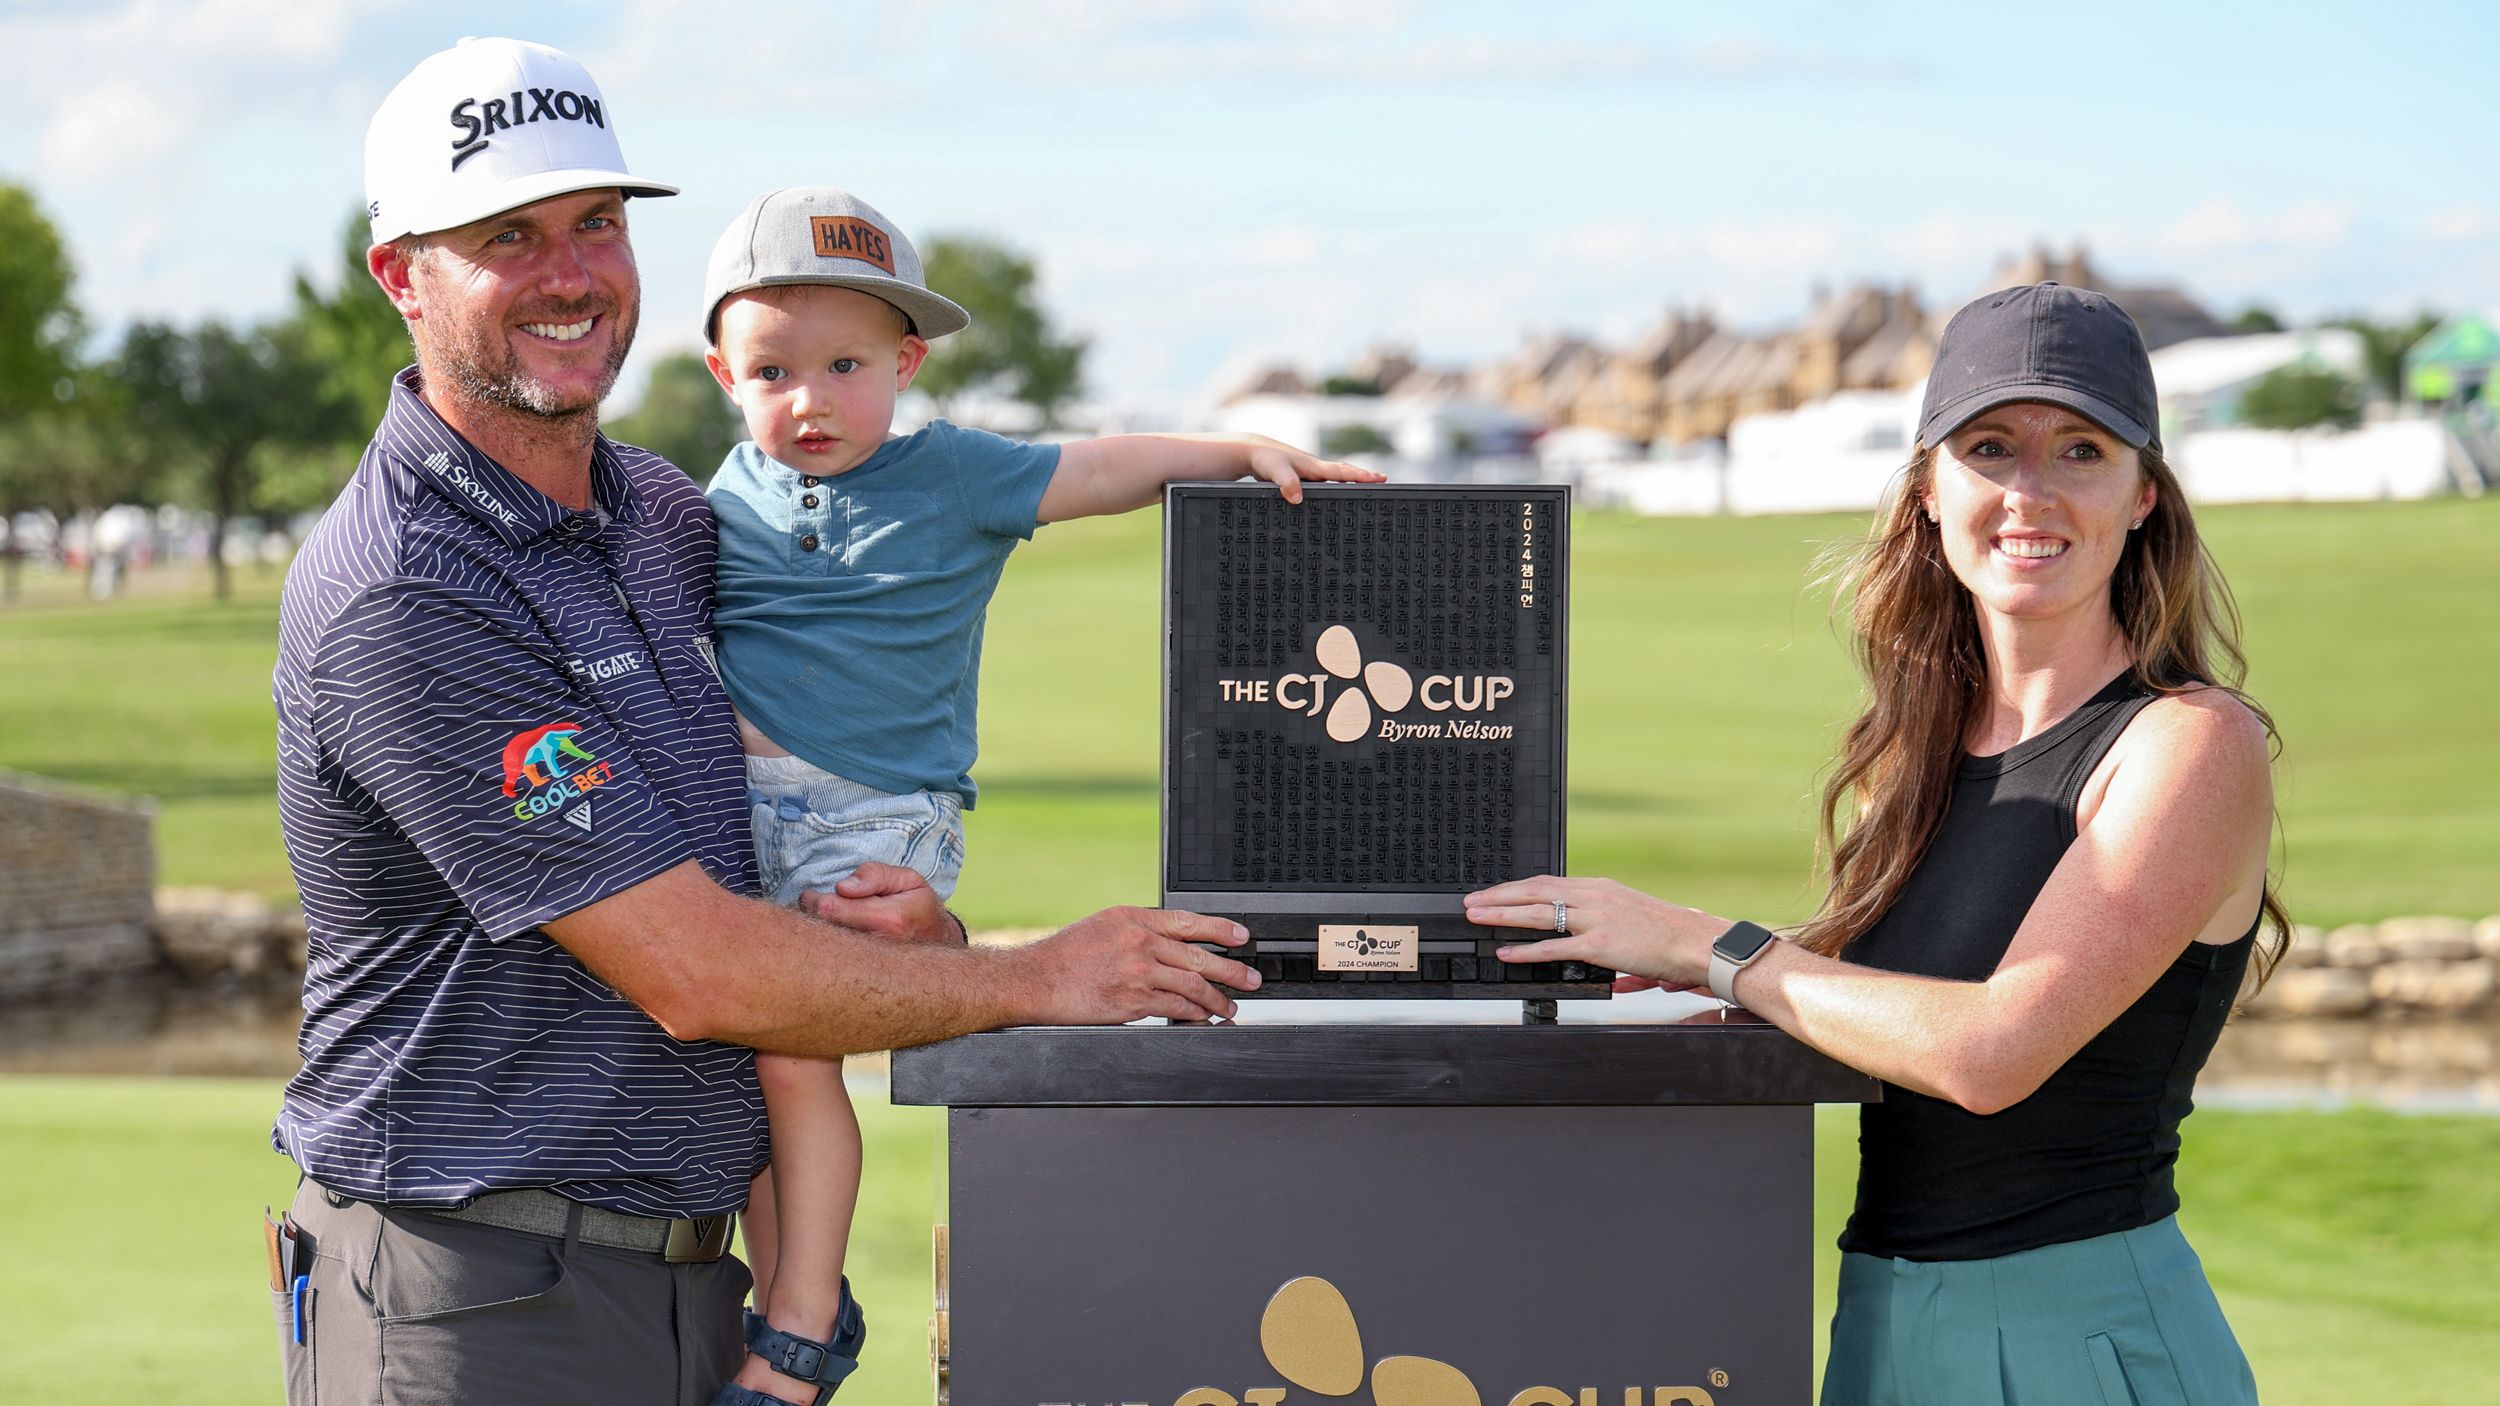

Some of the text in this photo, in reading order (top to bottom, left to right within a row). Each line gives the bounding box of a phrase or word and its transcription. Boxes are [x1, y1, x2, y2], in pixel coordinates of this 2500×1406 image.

[451, 88, 605, 150] SRIXON
[820, 223, 886, 262] HAYES
[447, 465, 519, 528] SKYLINE
[1520, 503, 1535, 608] 2024챔피언
[1219, 673, 1515, 718] THE CJ CUP
[1377, 719, 1514, 742] Byron Nelson
[514, 761, 614, 821] COOLBET
[1337, 960, 1399, 968] 2024 CHAMPION
[1347, 940, 1359, 950] CJ
[1379, 940, 1400, 949] CUP
